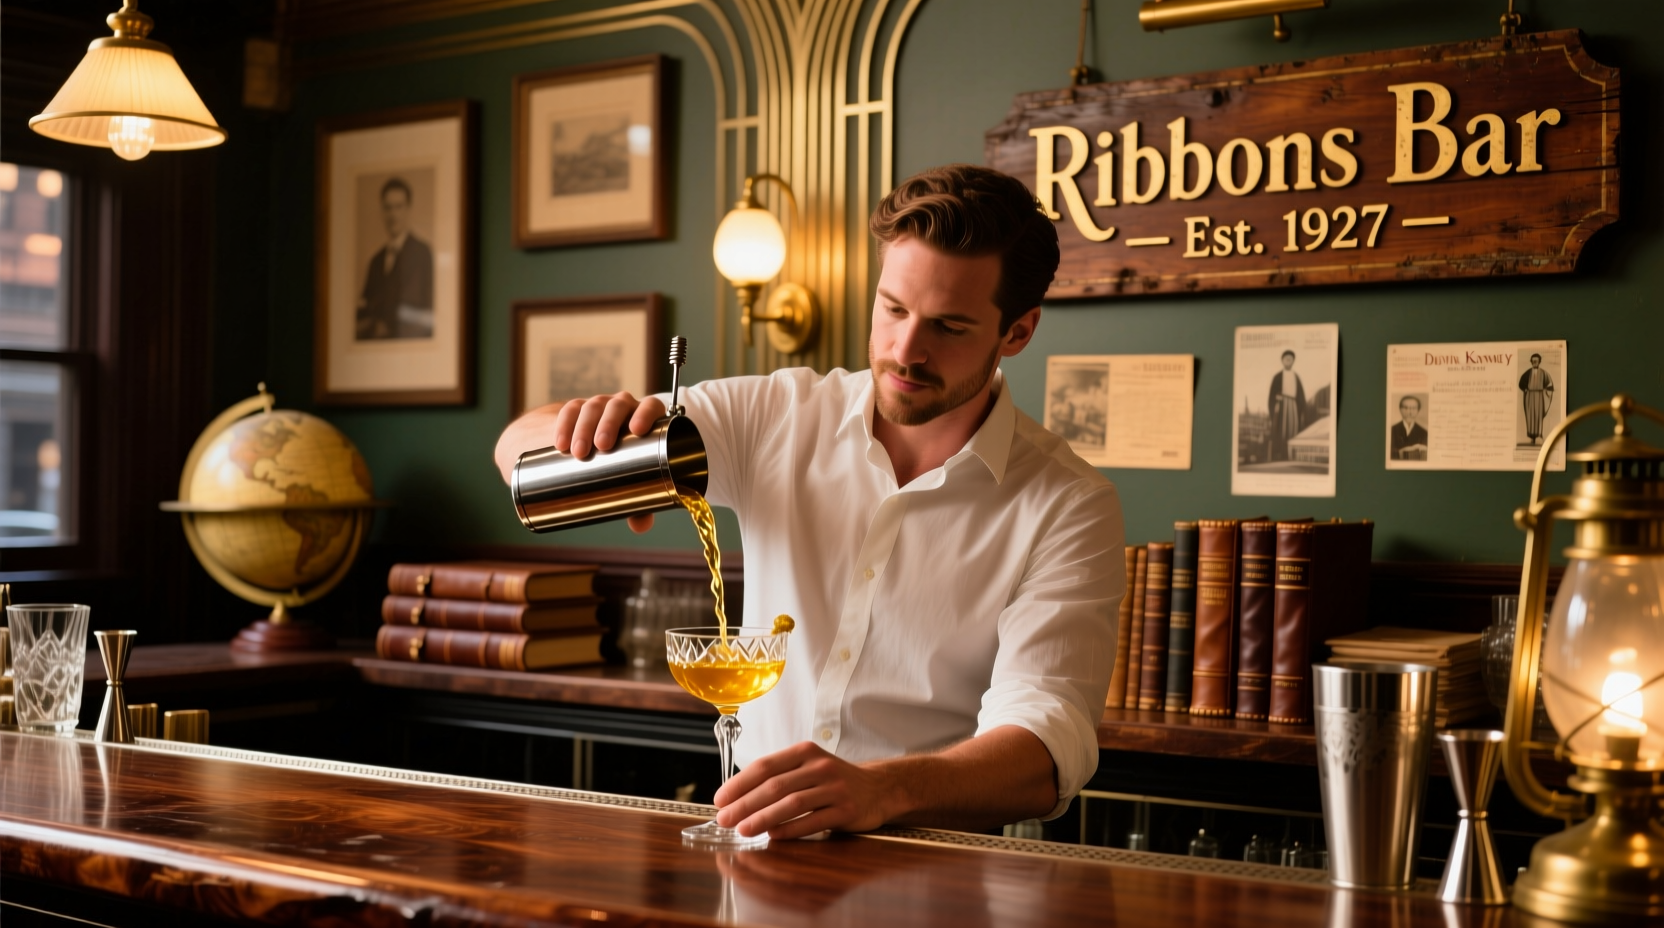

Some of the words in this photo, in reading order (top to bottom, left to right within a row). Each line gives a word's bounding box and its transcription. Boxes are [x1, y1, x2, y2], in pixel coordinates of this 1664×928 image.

[1028, 116, 1359, 243] Ribbons
[1387, 82, 1562, 186] Bar
[1183, 216, 1265, 259] Est.
[1283, 204, 1390, 253] 1927
